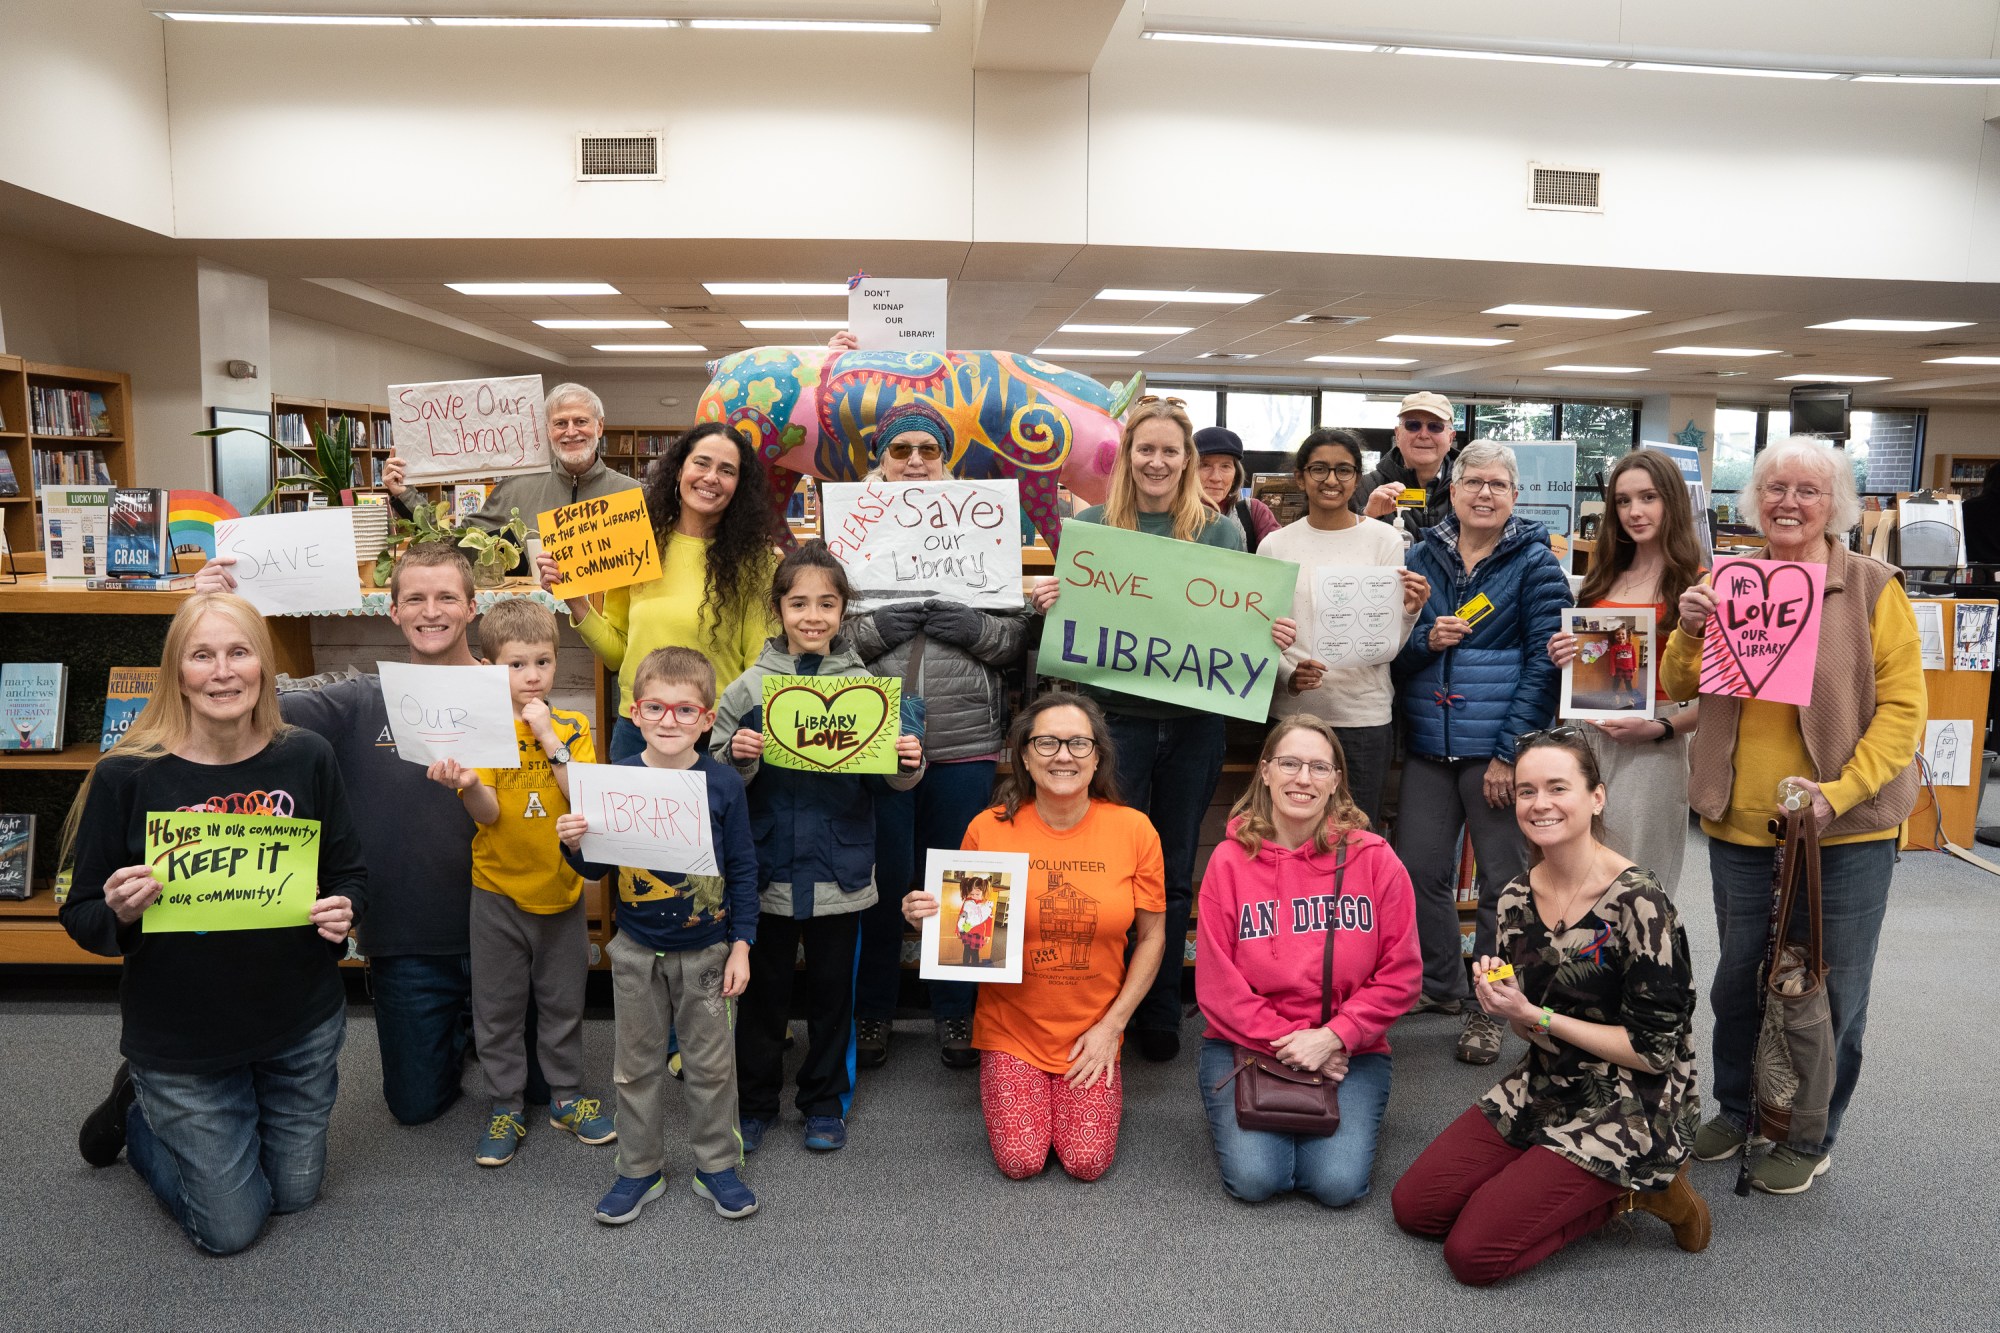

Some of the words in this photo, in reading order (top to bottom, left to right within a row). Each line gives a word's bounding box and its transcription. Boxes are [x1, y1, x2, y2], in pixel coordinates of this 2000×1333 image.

[873, 303, 904, 311] KIDNAP
[885, 316, 903, 324] OUR
[899, 330, 935, 338] LIBRARY!
[399, 388, 467, 423] Save
[476, 384, 526, 416] Our
[427, 403, 541, 467] Library!
[1529, 483, 1541, 491] on
[1547, 480, 1573, 492] Hold
[71, 494, 93, 503] LUCKY
[93, 494, 106, 504] DAY
[894, 487, 1004, 529] Save
[543, 533, 557, 547] FOR
[558, 526, 575, 542] THE
[578, 520, 598, 535] NEW
[603, 500, 646, 528] LIBRARY!
[827, 482, 895, 565] PLEASE
[597, 537, 611, 552] IN
[924, 533, 965, 551] our
[114, 549, 149, 565] CRASH
[232, 540, 324, 580] SAVE
[559, 571, 572, 584] UR
[892, 550, 988, 588] Library
[1065, 550, 1153, 599] SAVE
[1186, 577, 1270, 621] OUR
[1730, 575, 1757, 598] WE
[1727, 597, 1803, 630] LOVE
[1741, 629, 1768, 641] OUR
[1062, 619, 1268, 699] LIBRARY
[1737, 641, 1786, 666] LIBRARY
[4, 678, 33, 688] mary
[36, 676, 56, 688] kay
[111, 672, 141, 680] JONATHAN
[144, 672, 158, 680] JESS
[5, 686, 54, 698] andrews
[110, 681, 157, 693] KELLERMA
[400, 694, 478, 730] OUR
[794, 710, 857, 731] LIBRARY
[797, 727, 860, 751] LOVE
[523, 791, 548, 818] A
[578, 780, 702, 846] LIBRARY
[207, 823, 221, 837] IN
[225, 823, 246, 838] OUR
[168, 846, 248, 883] KEEP
[1028, 859, 1107, 873] VOLUNTEER
[169, 893, 192, 906] OUR
[1239, 900, 1280, 940] AN
[1292, 895, 1374, 934] DIEGO
[1034, 953, 1059, 964] SALE
[1036, 948, 1055, 958] FOR
